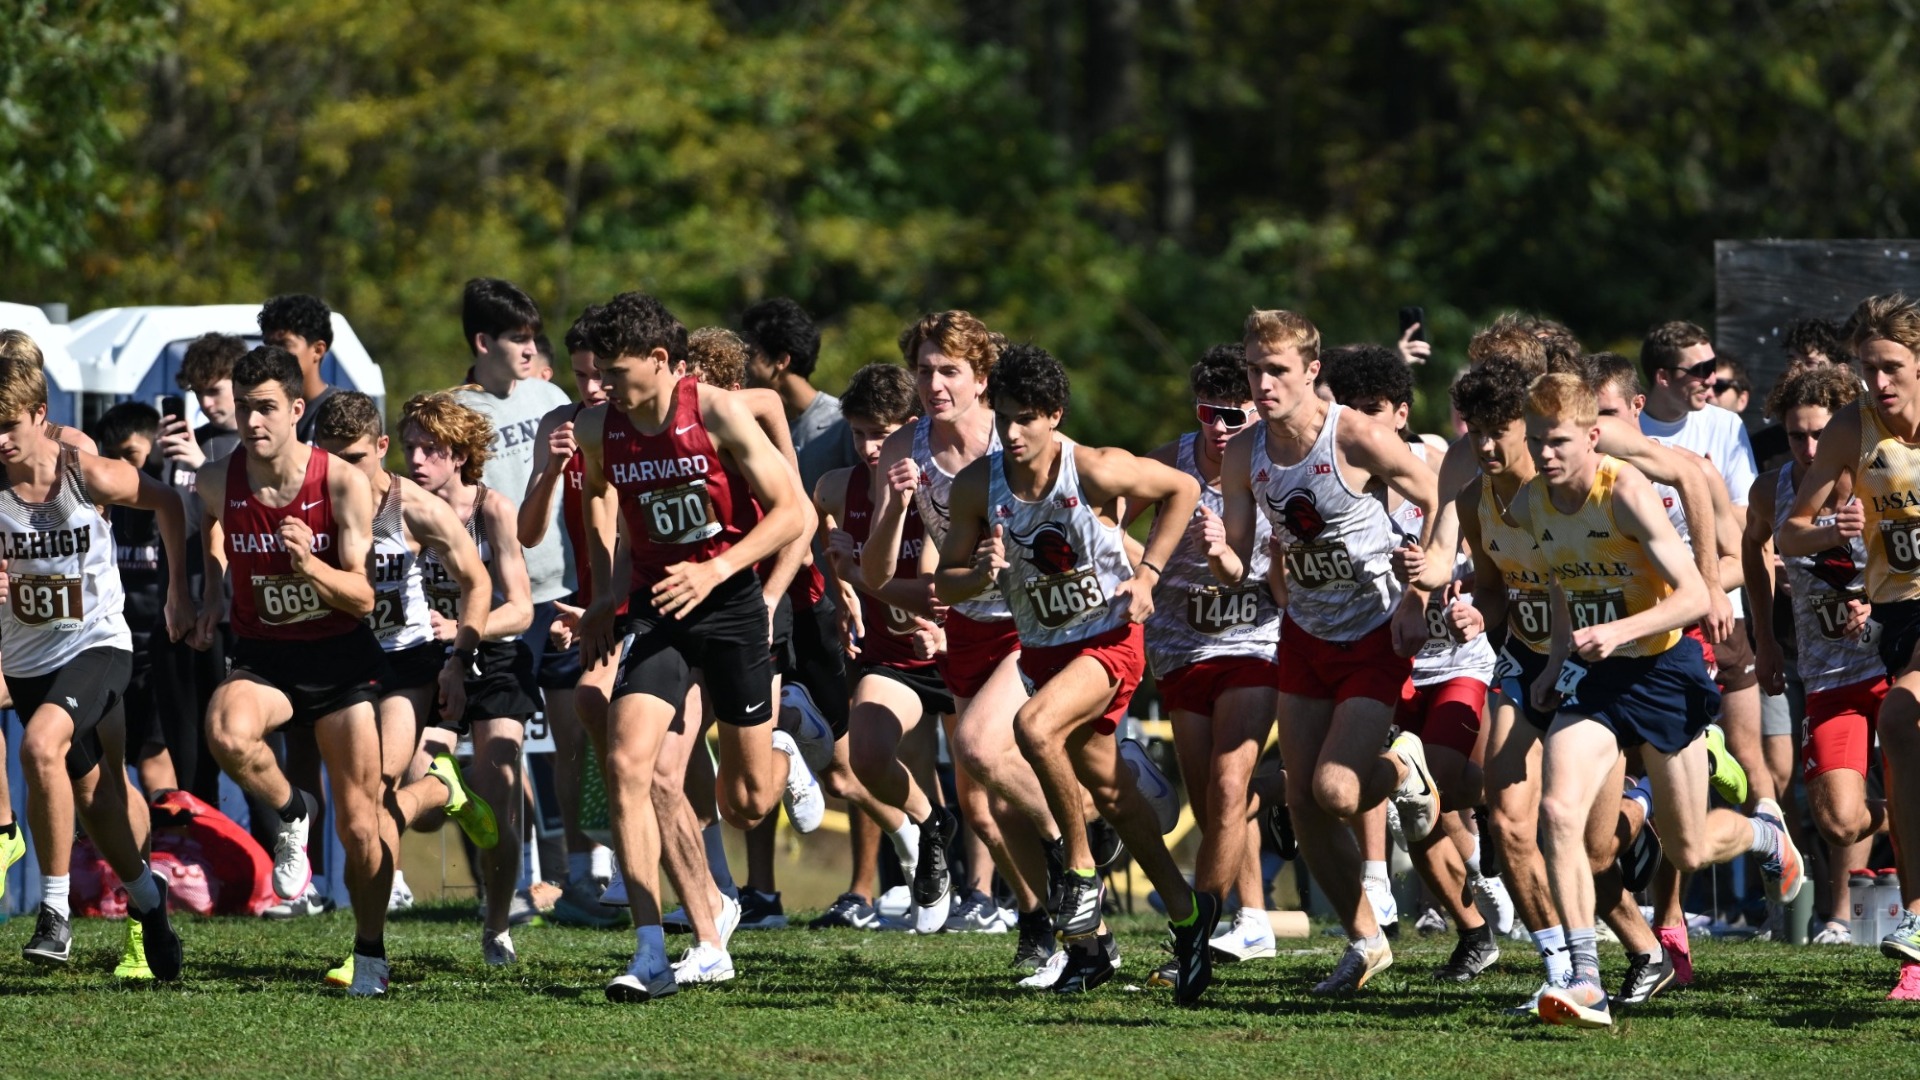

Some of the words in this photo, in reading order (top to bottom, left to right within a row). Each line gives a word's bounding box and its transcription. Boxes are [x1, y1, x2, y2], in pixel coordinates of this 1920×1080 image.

[612, 454, 709, 484] HARVARD
[652, 493, 707, 535] 670
[0, 524, 91, 560] LEHIGH
[230, 533, 331, 553] HARVRD
[1288, 549, 1353, 581] 1456
[19, 585, 70, 618] 931
[264, 583, 320, 615] 669
[1031, 575, 1104, 619] 1463
[1191, 592, 1258, 627] 1446
[1518, 601, 1551, 633] 87
